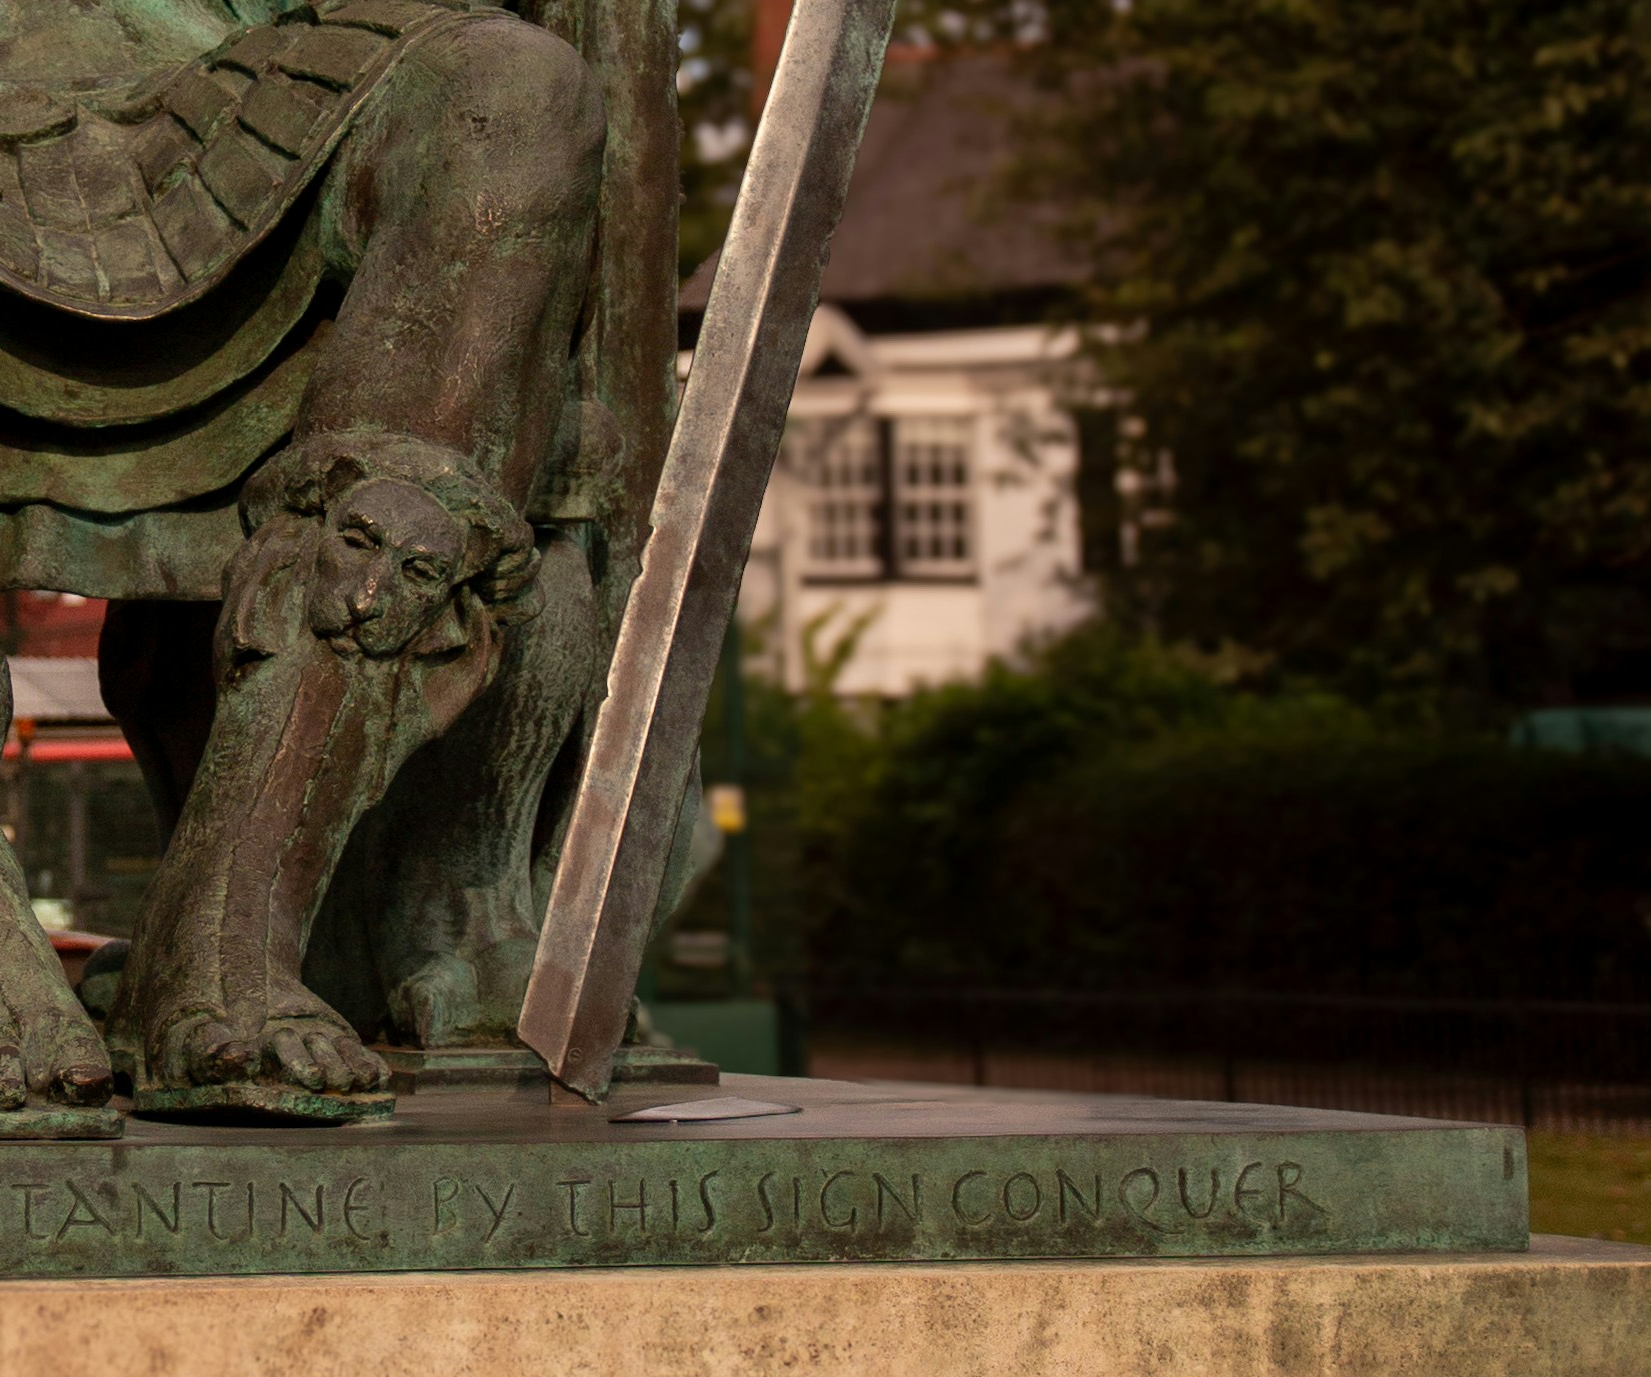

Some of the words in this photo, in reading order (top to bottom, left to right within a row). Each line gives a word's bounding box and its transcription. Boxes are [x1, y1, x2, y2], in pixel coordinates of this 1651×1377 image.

[430, 1176, 516, 1245] BY
[556, 1169, 720, 1236] THIS
[757, 1170, 923, 1232] SIGN
[950, 1161, 1333, 1236] CONQUER
